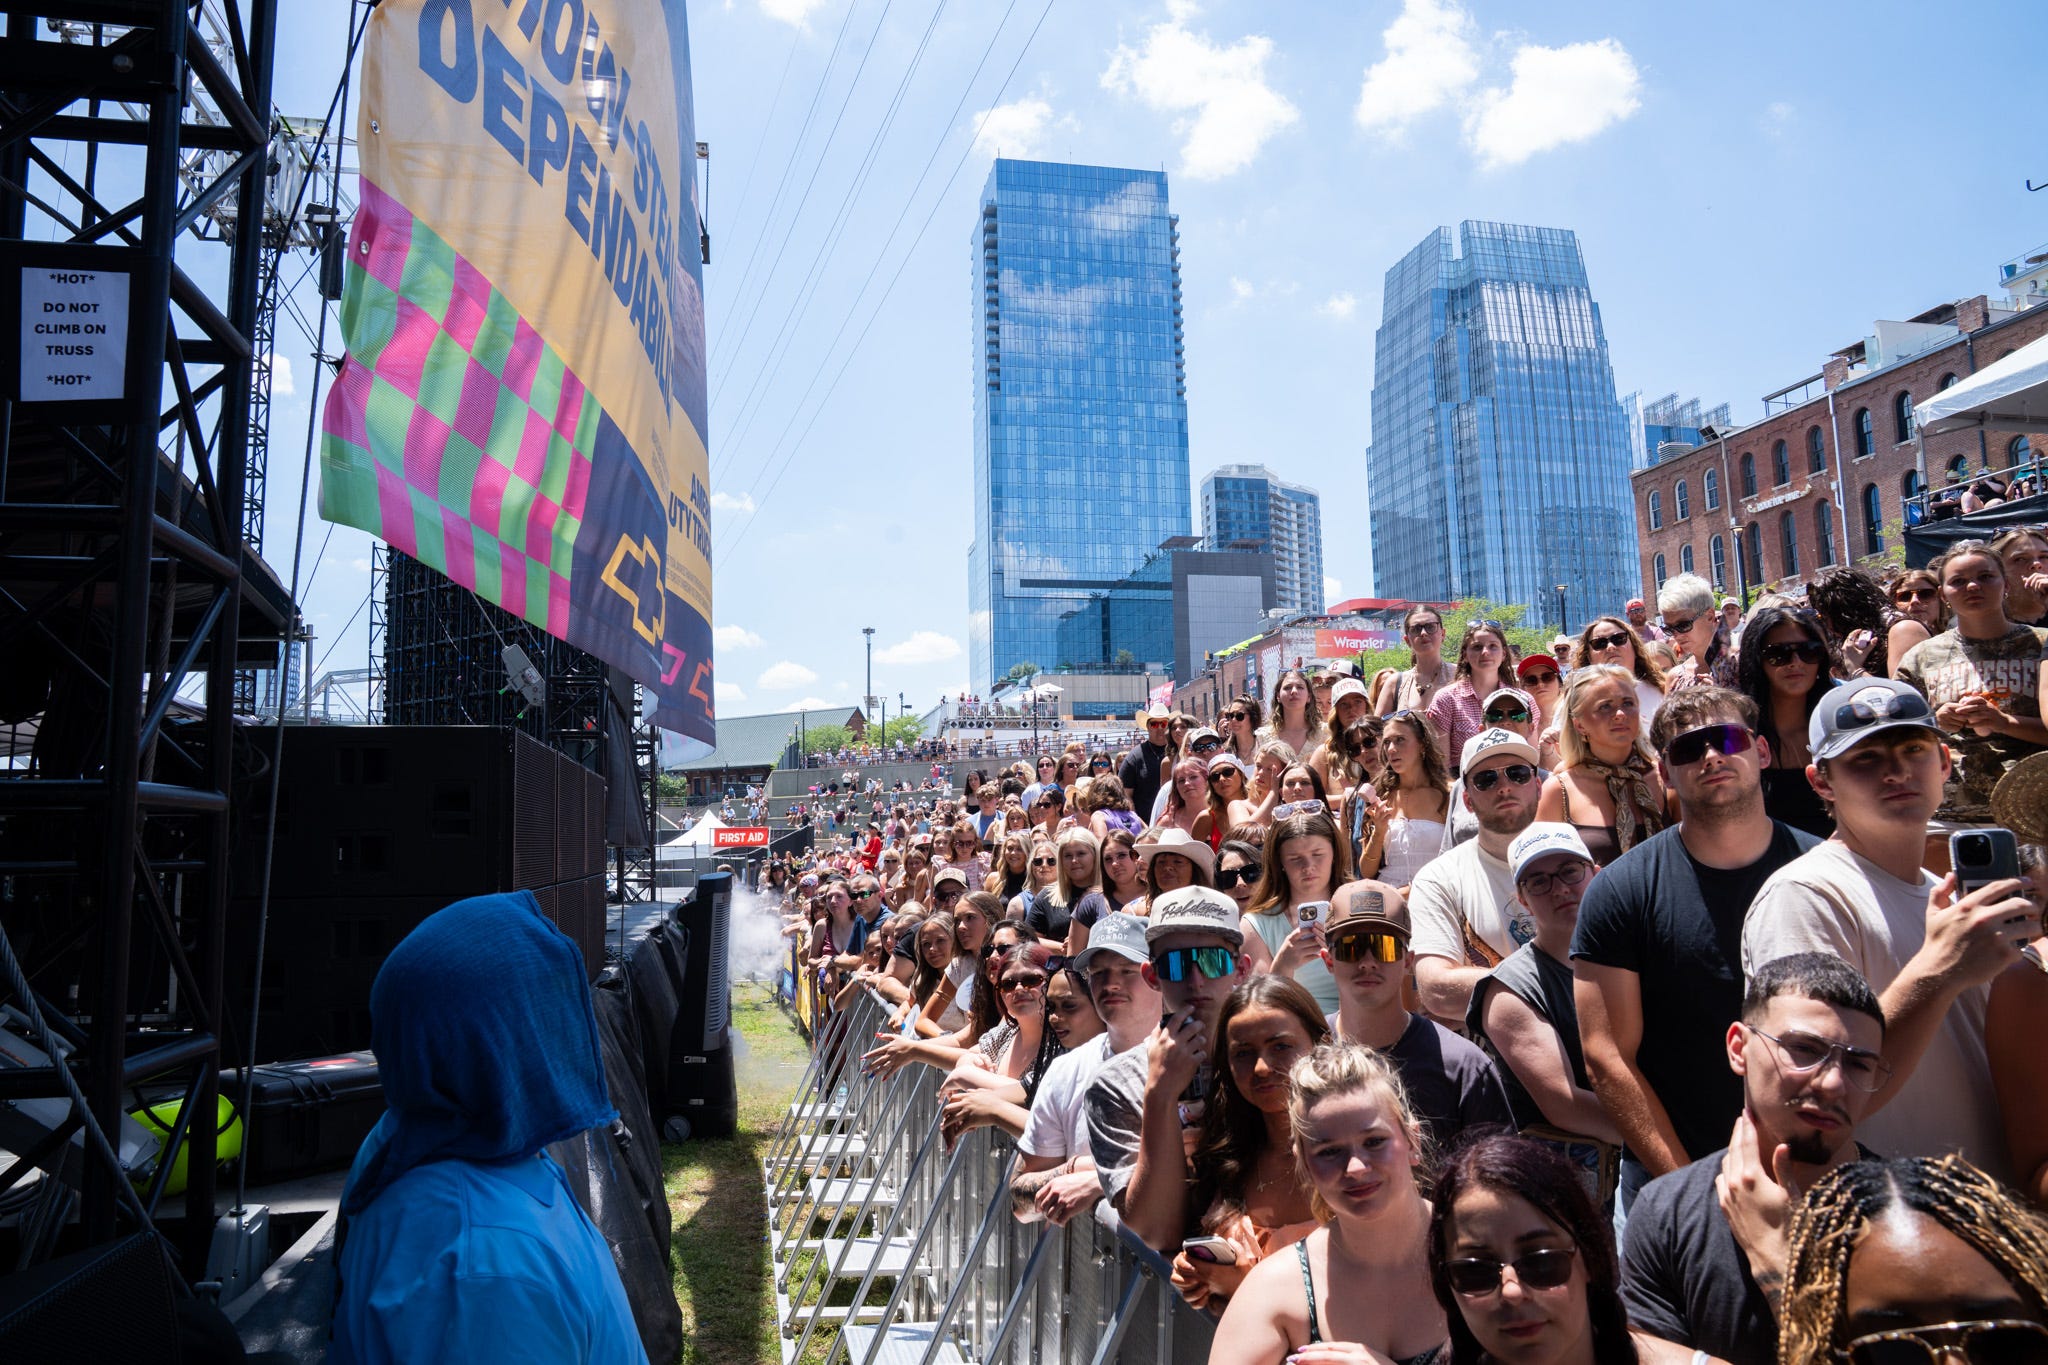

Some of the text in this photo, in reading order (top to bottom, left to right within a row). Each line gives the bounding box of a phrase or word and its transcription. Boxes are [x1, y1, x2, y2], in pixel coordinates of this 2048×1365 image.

[43, 302, 100, 313] DO NOT
[34, 323, 106, 334] CLIMB ON
[46, 345, 94, 355] TRUSS
[1333, 636, 1384, 651] Wrangler
[719, 831, 764, 842] FIRST AID
[1096, 933, 1129, 943] COWBOY
